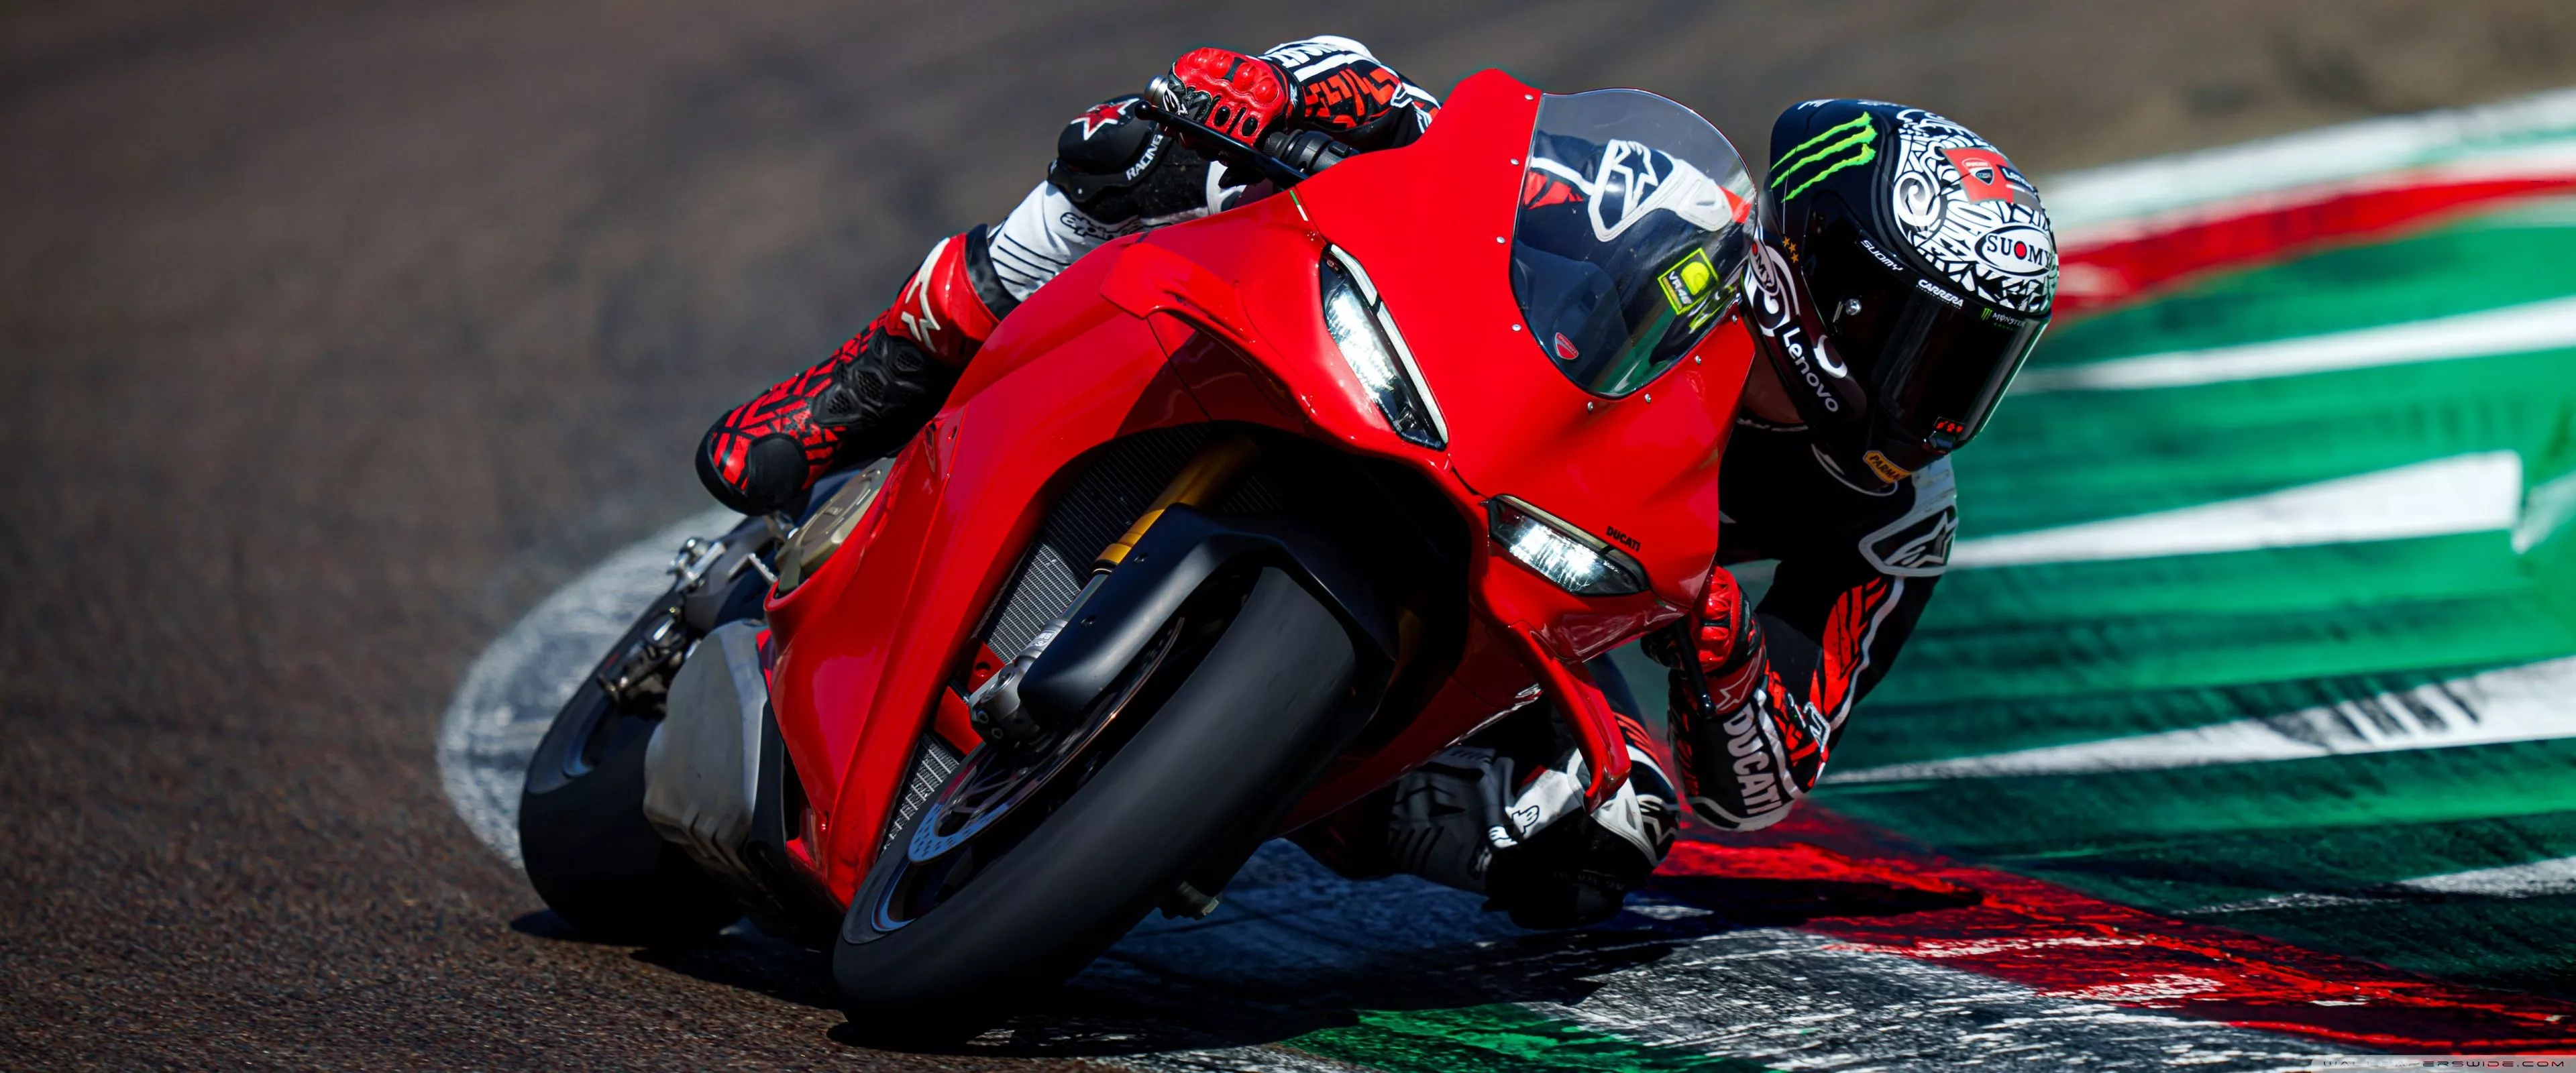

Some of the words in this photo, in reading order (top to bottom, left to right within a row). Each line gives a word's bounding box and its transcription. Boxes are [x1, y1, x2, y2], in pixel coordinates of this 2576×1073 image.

[1126, 134, 1163, 181] RACING
[1861, 239, 1903, 271] SUOMY
[1987, 235, 2051, 268] SUOMY
[1918, 279, 1964, 308] CARRERA
[1992, 312, 2025, 328] MONSTER
[1783, 327, 1838, 412] Lenovo
[1605, 526, 1641, 553] DUCATI
[1723, 703, 1782, 815] DUCATI
